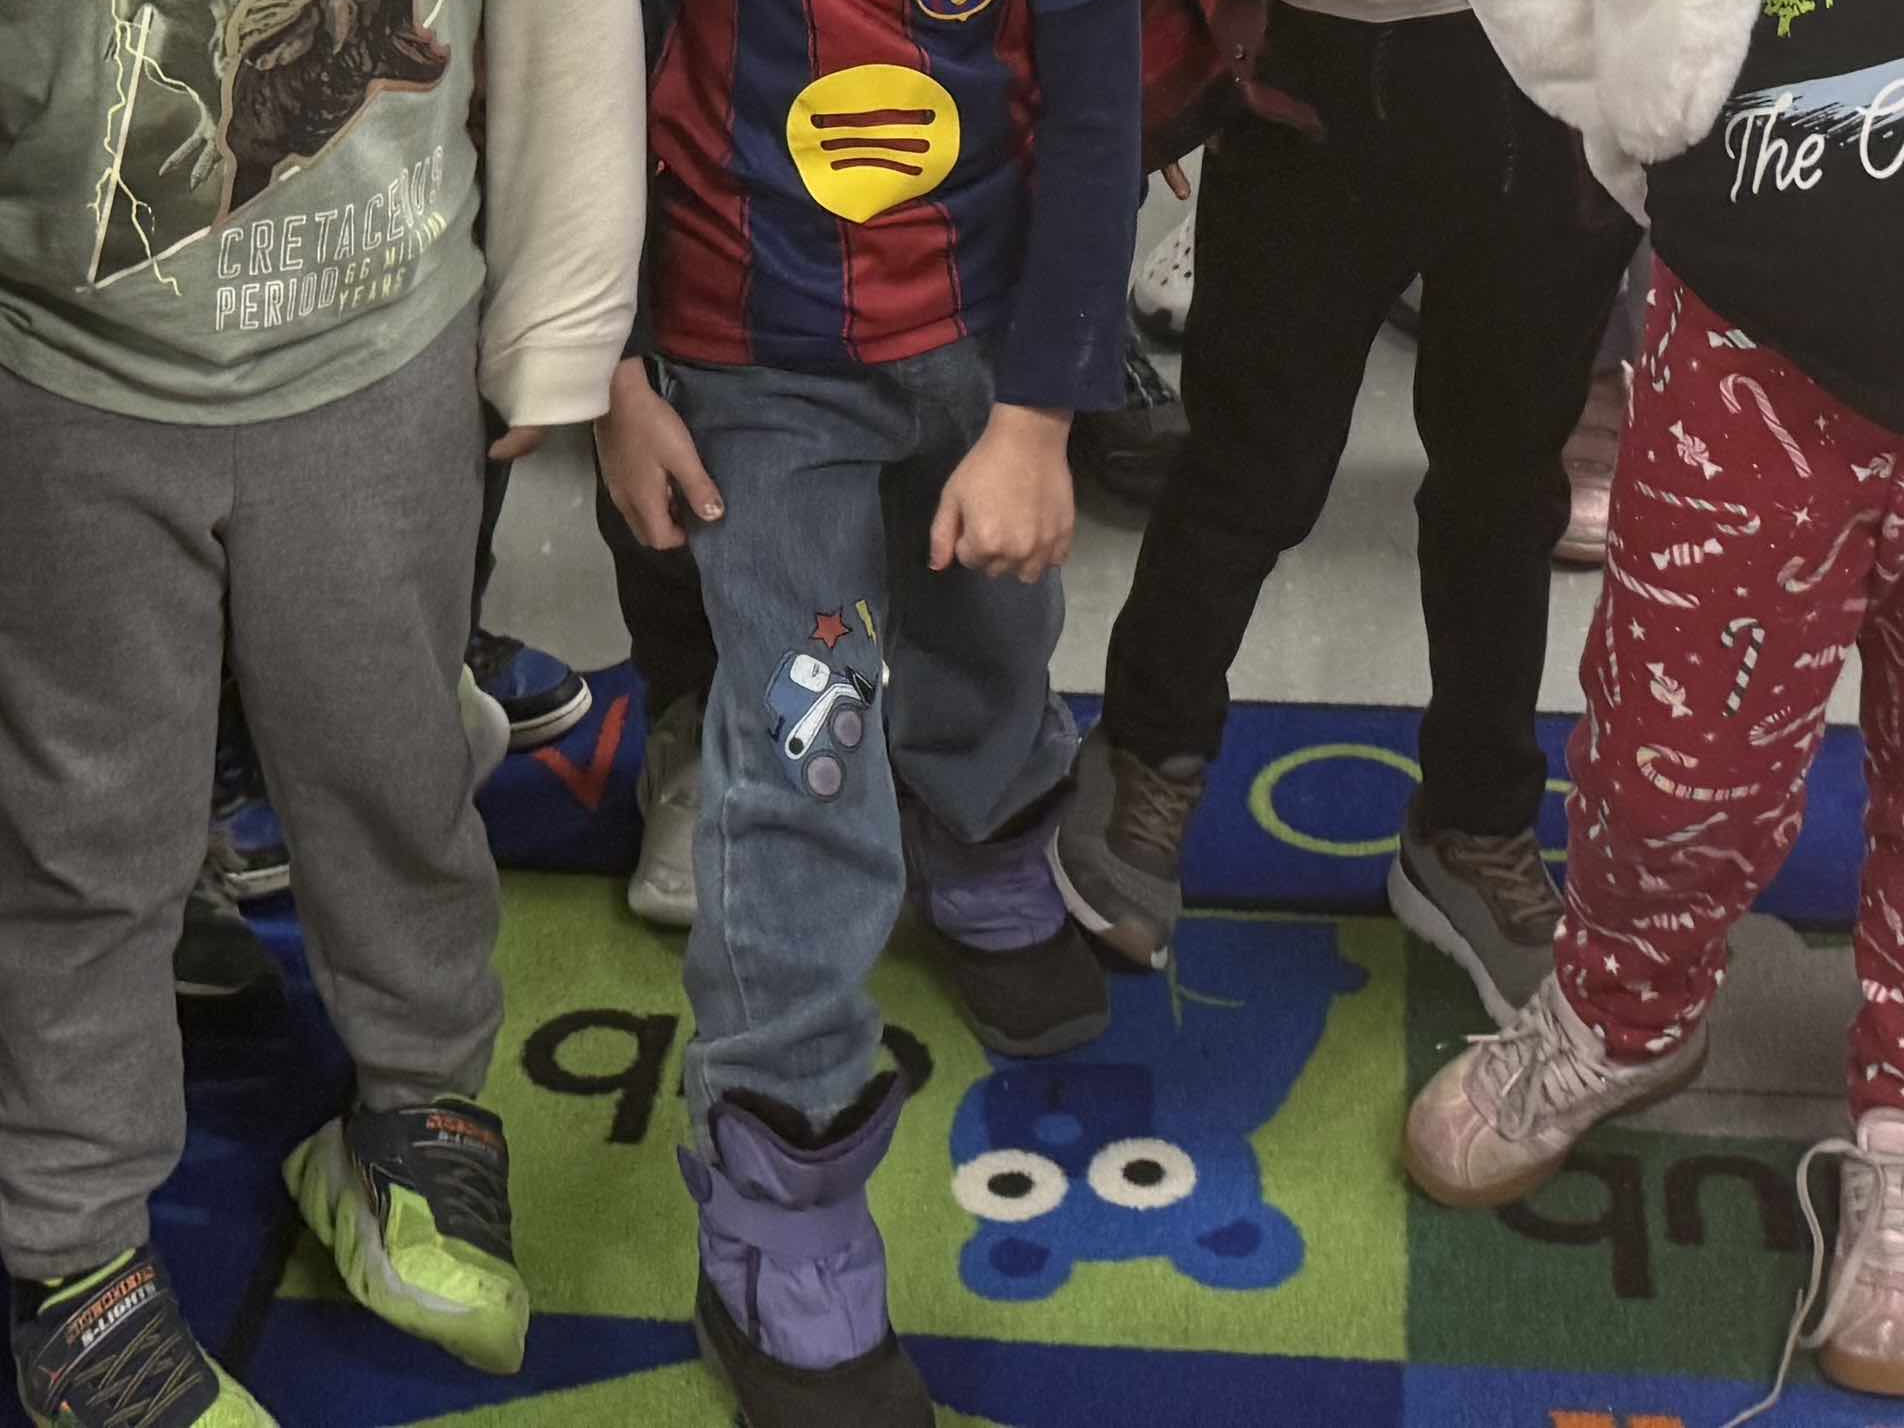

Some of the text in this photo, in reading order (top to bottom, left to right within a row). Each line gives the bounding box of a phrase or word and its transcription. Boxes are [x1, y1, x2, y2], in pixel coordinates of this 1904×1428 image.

[1725, 91, 1825, 203] The
[338, 267, 406, 312] YEARS
[344, 258, 371, 284] 66
[215, 267, 340, 331] PERIOD
